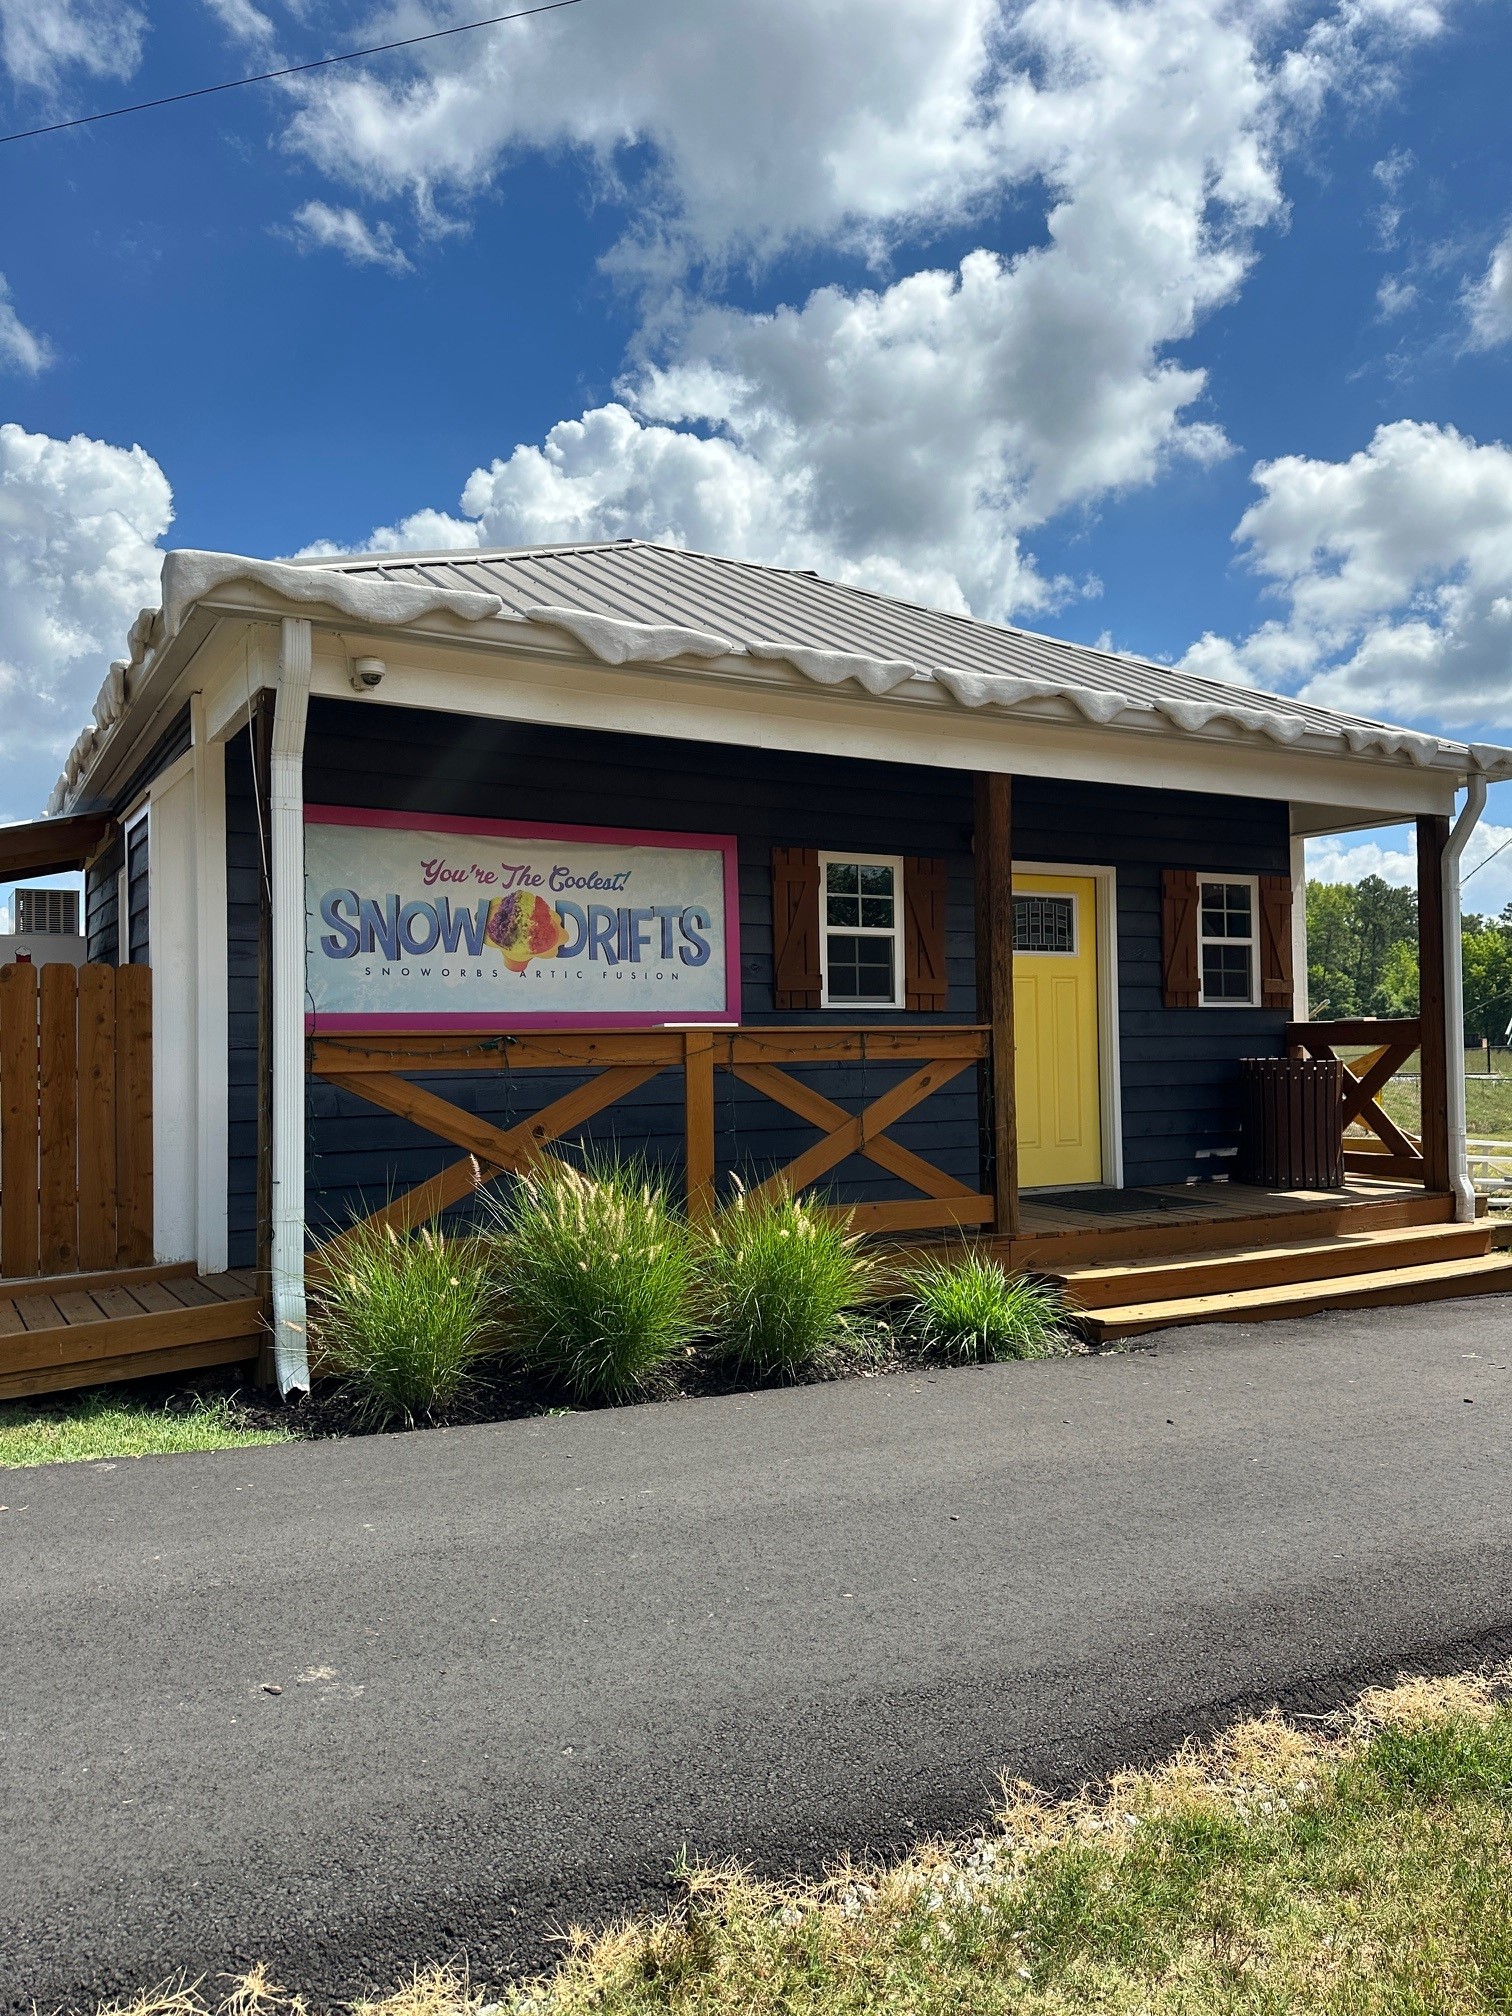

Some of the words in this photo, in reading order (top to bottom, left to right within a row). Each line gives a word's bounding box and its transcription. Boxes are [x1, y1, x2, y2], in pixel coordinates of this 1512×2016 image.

[420, 858, 498, 886] You're
[502, 862, 545, 890] The
[549, 864, 632, 892] Coolest!
[319, 887, 491, 961] SNOW
[555, 899, 712, 967] DRIFTS
[364, 967, 498, 978] SNOWORBS
[519, 970, 583, 979] ARTIC
[602, 971, 679, 980] FUSION
